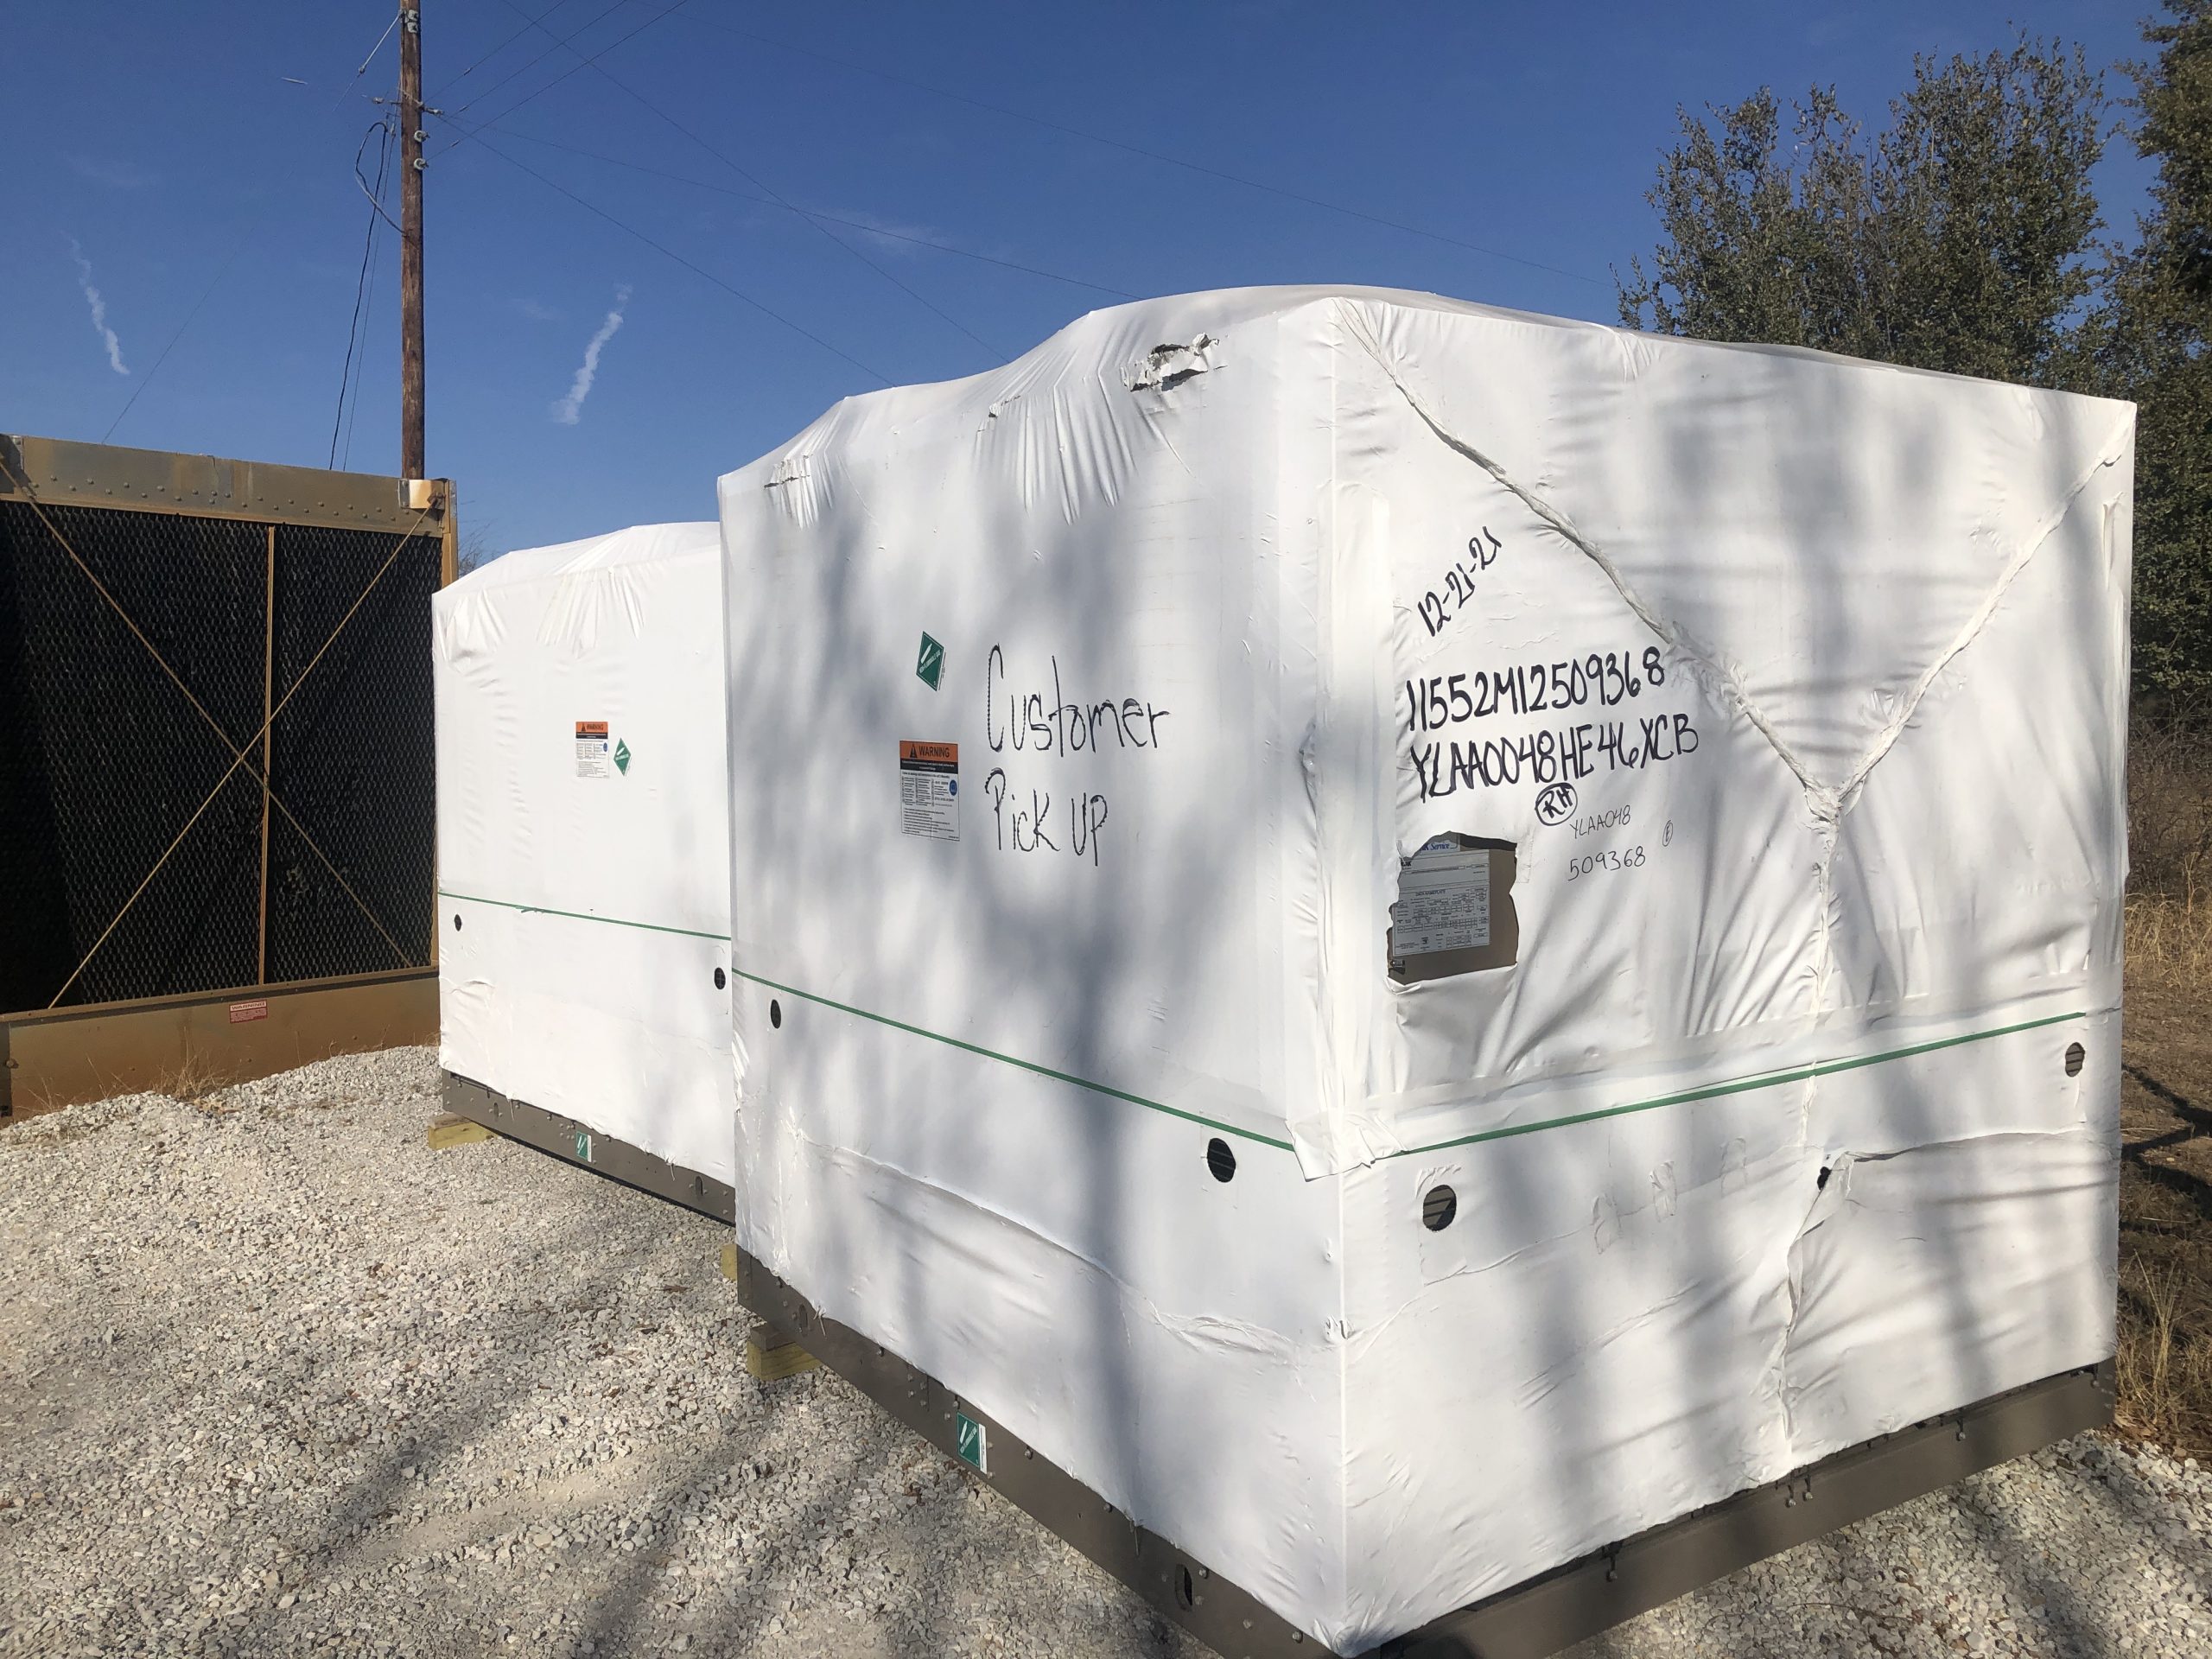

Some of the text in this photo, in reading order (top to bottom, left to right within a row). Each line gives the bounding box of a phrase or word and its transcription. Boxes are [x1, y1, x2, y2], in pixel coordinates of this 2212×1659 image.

[1417, 525, 1502, 637] 12-21-21
[987, 643, 1170, 758] Customer
[918, 745, 950, 759] WARNING
[1409, 713, 1699, 804] YLAA0048HE46XCB
[1538, 786, 1573, 819] RH
[1569, 804, 1631, 840] YLAA048
[1430, 842, 1450, 851] Service
[1567, 845, 1646, 882] 509368
